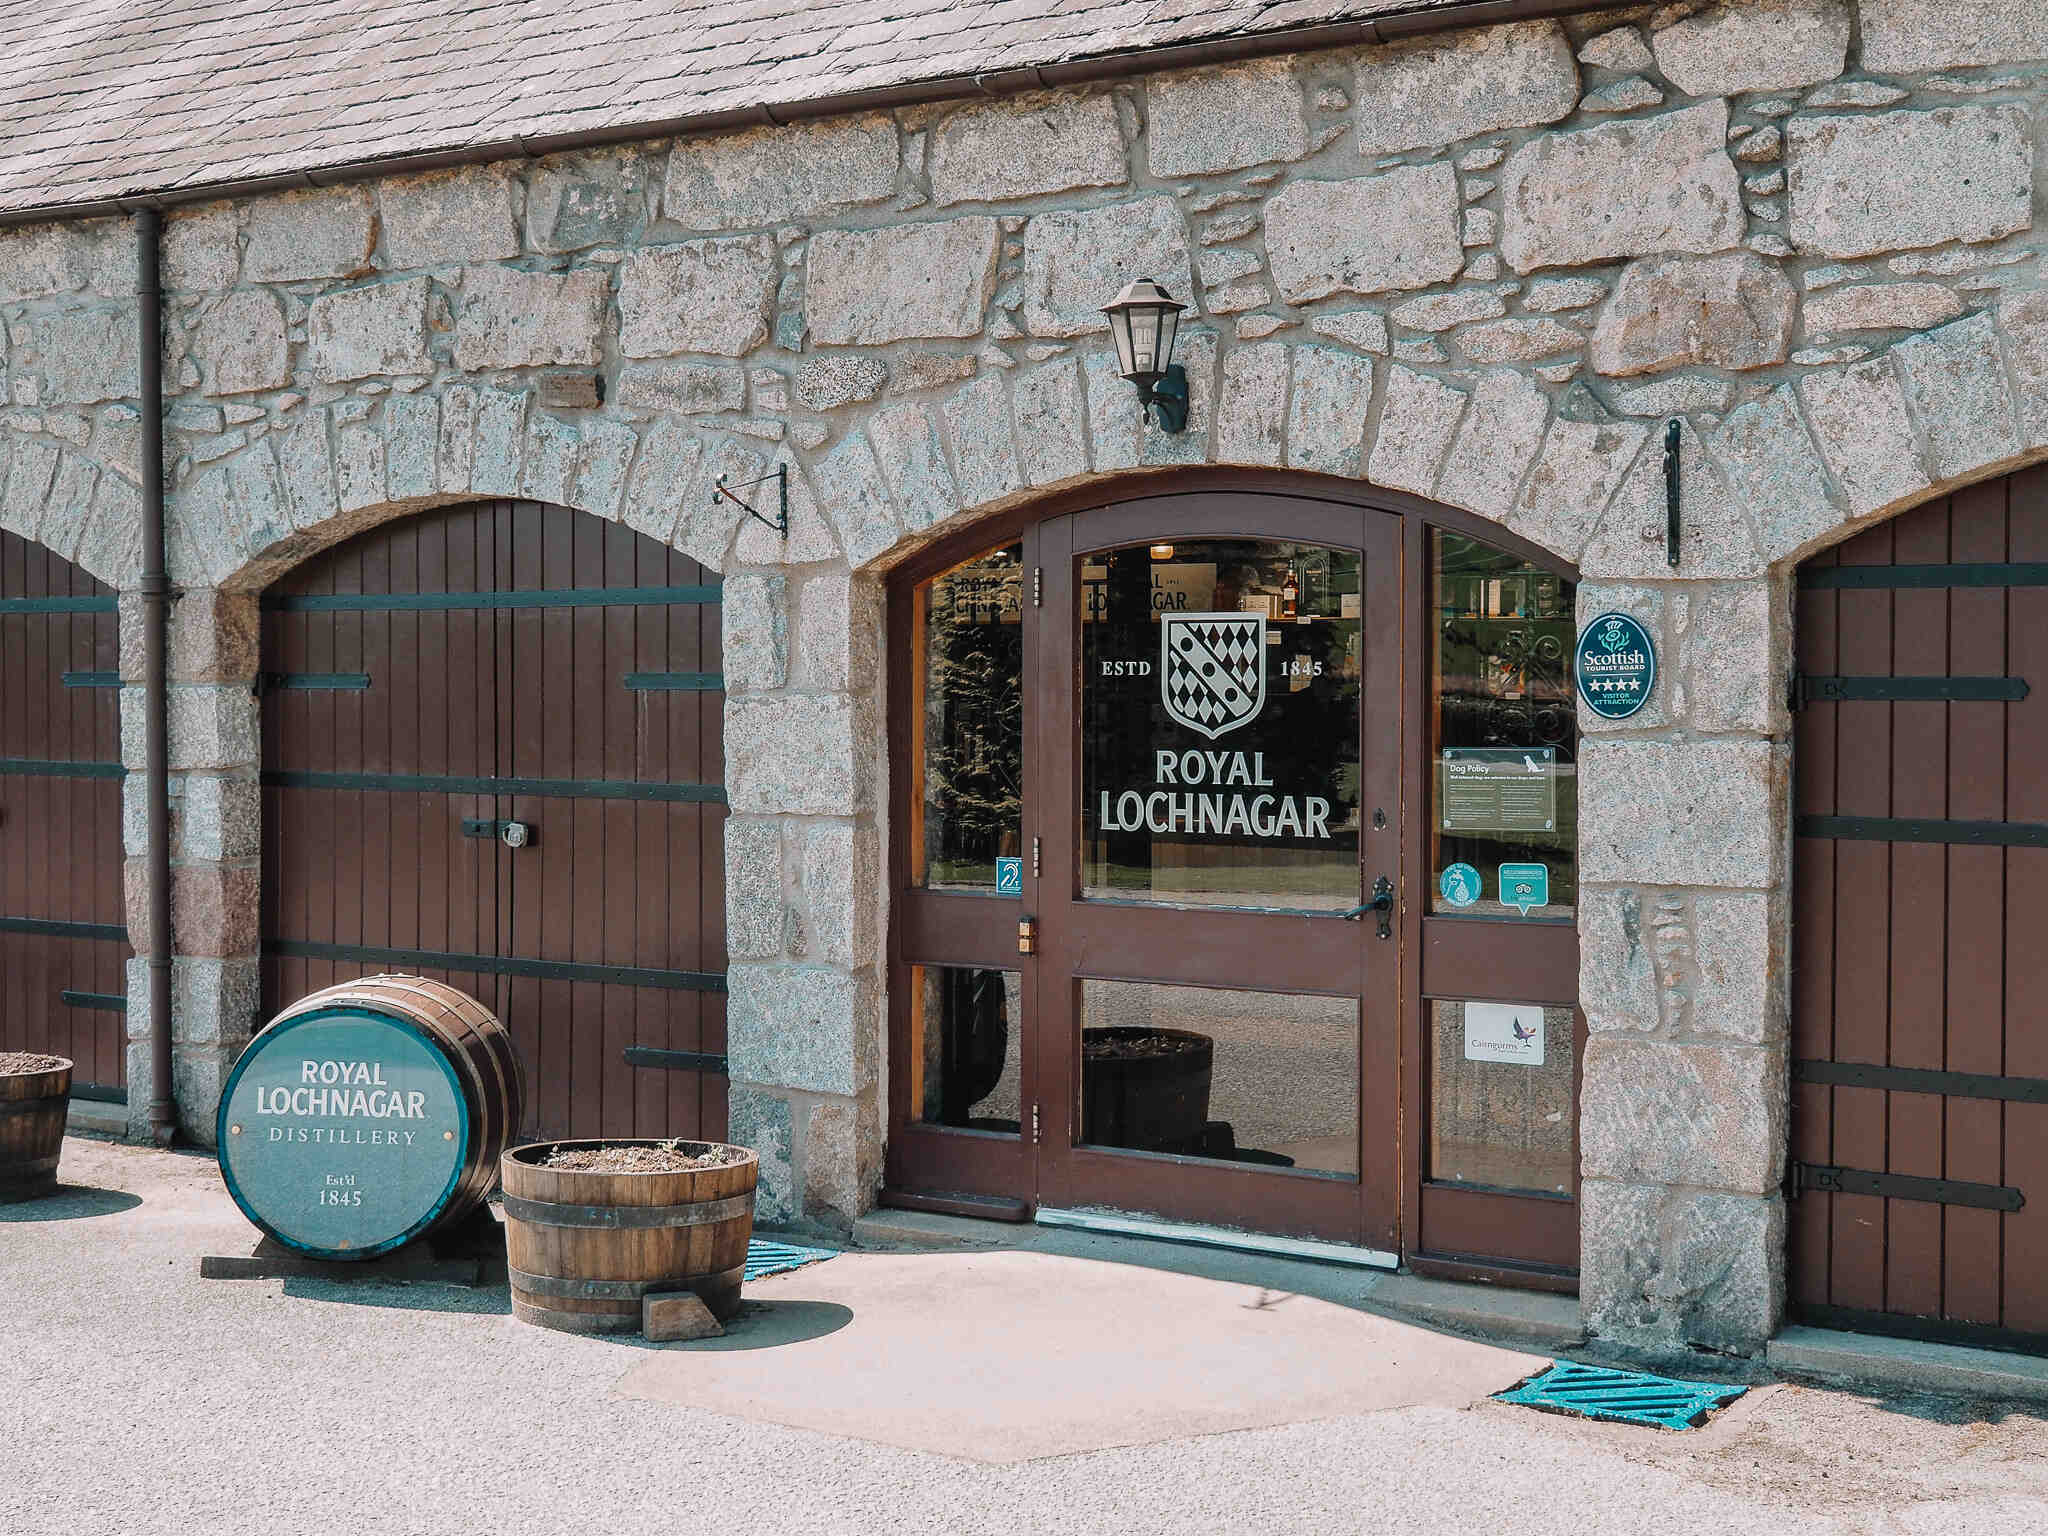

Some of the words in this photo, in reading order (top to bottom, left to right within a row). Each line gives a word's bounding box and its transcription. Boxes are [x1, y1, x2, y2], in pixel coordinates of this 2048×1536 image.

[1584, 650, 1645, 666] Scottish
[1101, 661, 1151, 676] ESTD
[1280, 661, 1322, 677] 1845
[1156, 750, 1273, 786] ROYAL
[1450, 764, 1466, 774] Dog
[1467, 764, 1489, 774] Policy
[1100, 790, 1331, 839] LOCHNAGAR
[301, 1060, 387, 1086] ROYAL
[256, 1086, 425, 1119] LOCHNAGAR
[269, 1127, 417, 1145] DISTILLERY
[319, 1190, 361, 1207] 1845
